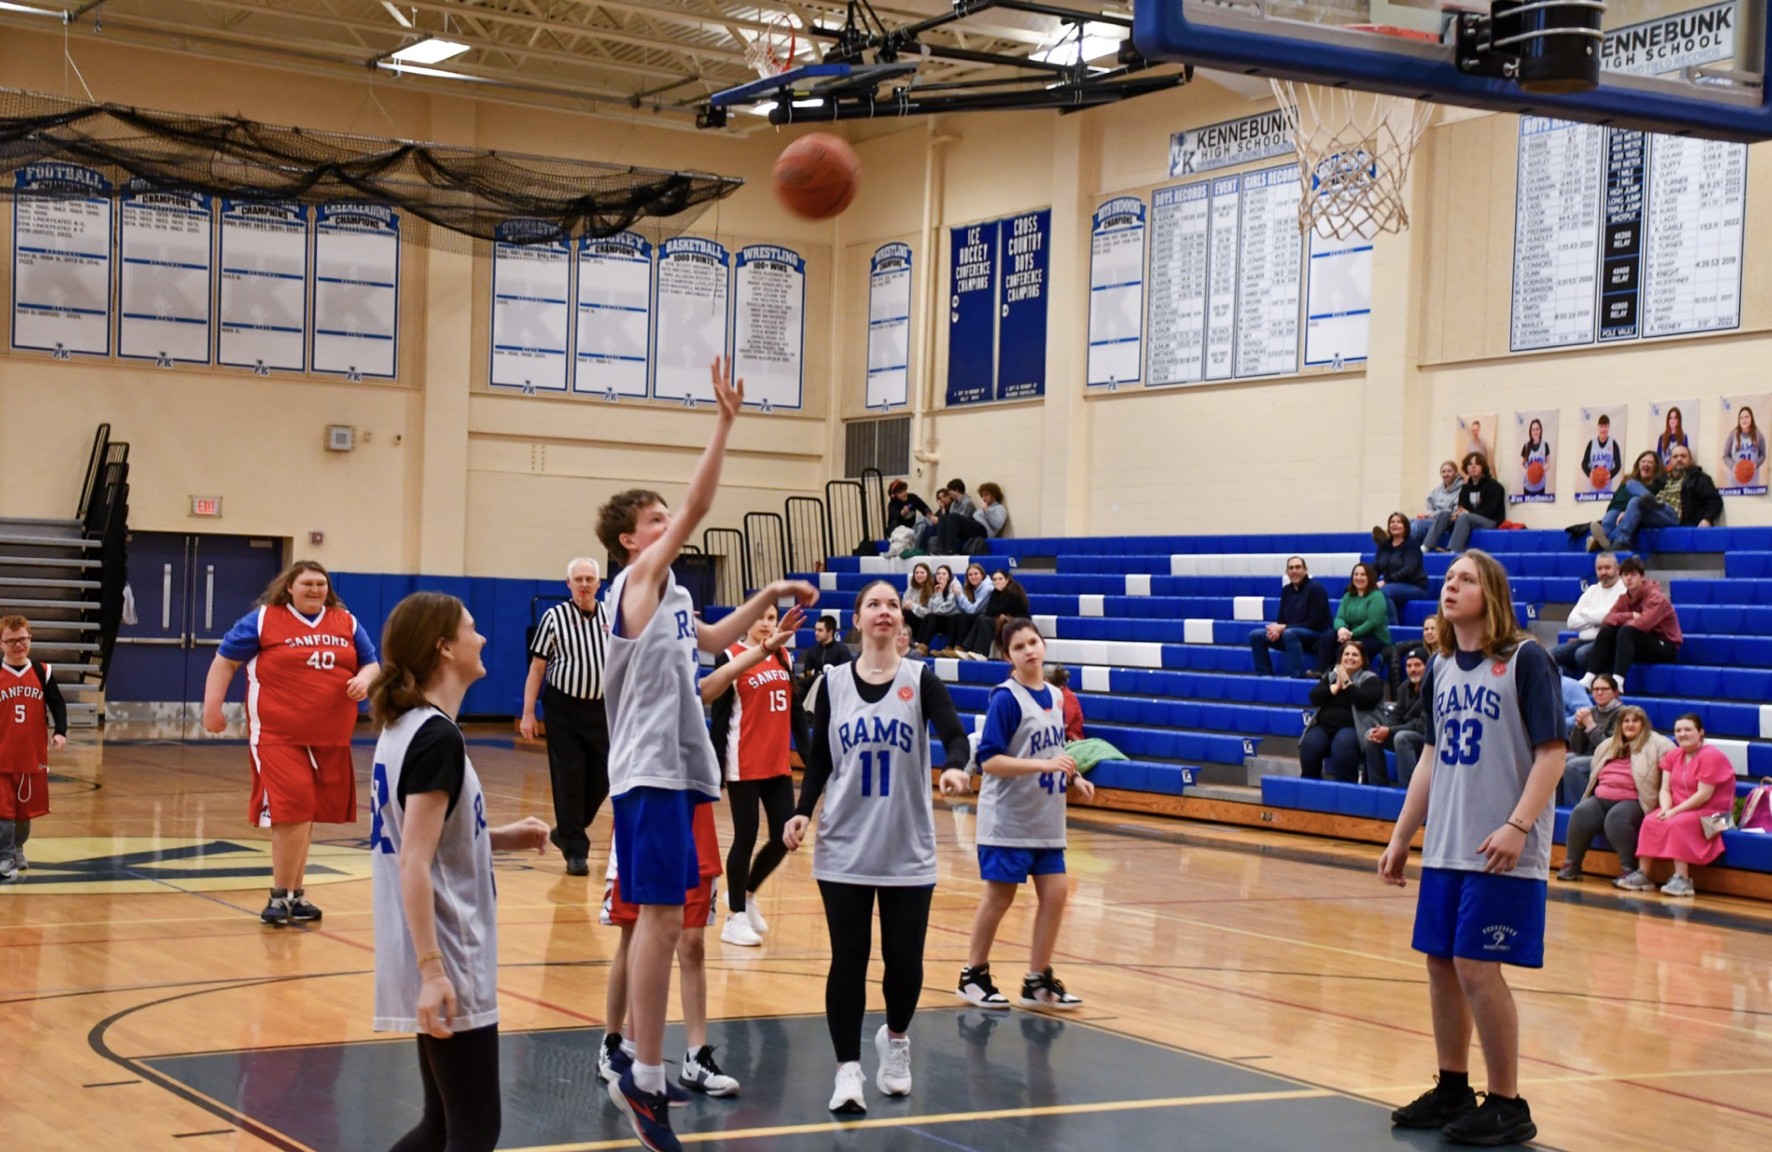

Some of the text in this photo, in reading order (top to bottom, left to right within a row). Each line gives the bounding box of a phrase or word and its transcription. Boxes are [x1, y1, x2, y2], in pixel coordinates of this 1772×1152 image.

[1601, 7, 1733, 58] ENNEBUNK
[1600, 33, 1722, 69] IGH SCHOOL
[1623, 140, 1642, 149] METER
[1624, 131, 1642, 141] METER
[1201, 132, 1288, 160] HIGH SCHOOL
[1623, 157, 1641, 168] METER
[25, 165, 102, 189] FOOTBALL
[1244, 172, 1267, 190] GIRLS
[1268, 167, 1301, 186] RECORD
[1621, 167, 1634, 177] MILE
[1621, 176, 1634, 186] MILE
[1155, 190, 1173, 207] BOYS
[1174, 184, 1208, 204] RECORDS
[1215, 178, 1238, 196] EVENT
[1624, 183, 1640, 194] JUMP
[142, 193, 192, 208] CHAMPIONS
[1608, 192, 1641, 206] LONG JUMP
[1625, 201, 1641, 212] JUMP
[241, 206, 288, 220] CHAMPIONS
[335, 215, 380, 229] CHAMPIONS
[1013, 215, 1038, 235] CROSS
[1103, 215, 1133, 230] CHAMPIONS
[967, 227, 981, 245] ICE
[1008, 231, 1042, 256] COUNTRY
[1613, 239, 1631, 249] RELAY
[595, 244, 635, 257] CHAMPIONS
[666, 238, 723, 259] BASKETBALL
[743, 247, 798, 266] WRESTLING
[959, 243, 988, 263] HOCKEY
[674, 254, 715, 267] 1000 POINTS
[753, 262, 787, 273] 100+ WINS
[955, 260, 991, 279] CONFERENCE
[1014, 252, 1034, 273] BOYS
[957, 275, 989, 293] CHAMPIONS
[1005, 269, 1042, 288] CONFERENCE
[1611, 274, 1630, 284] RELAY
[1008, 283, 1040, 302] CHAMPIONS
[1610, 310, 1628, 319] RELAY
[1602, 326, 1634, 338] POLE VAULT
[197, 499, 215, 513] EXIT
[284, 633, 349, 648] SANFORD
[306, 650, 336, 670] 40
[748, 669, 790, 689] SANFO
[0, 685, 44, 702] ANFOR
[769, 689, 788, 712] 15
[1437, 682, 1502, 721] RAMS
[15, 704, 26, 723] 5
[838, 716, 914, 754] RAMS
[1029, 725, 1066, 756] RAM
[1440, 718, 1483, 766] 33
[859, 750, 891, 797] 11
